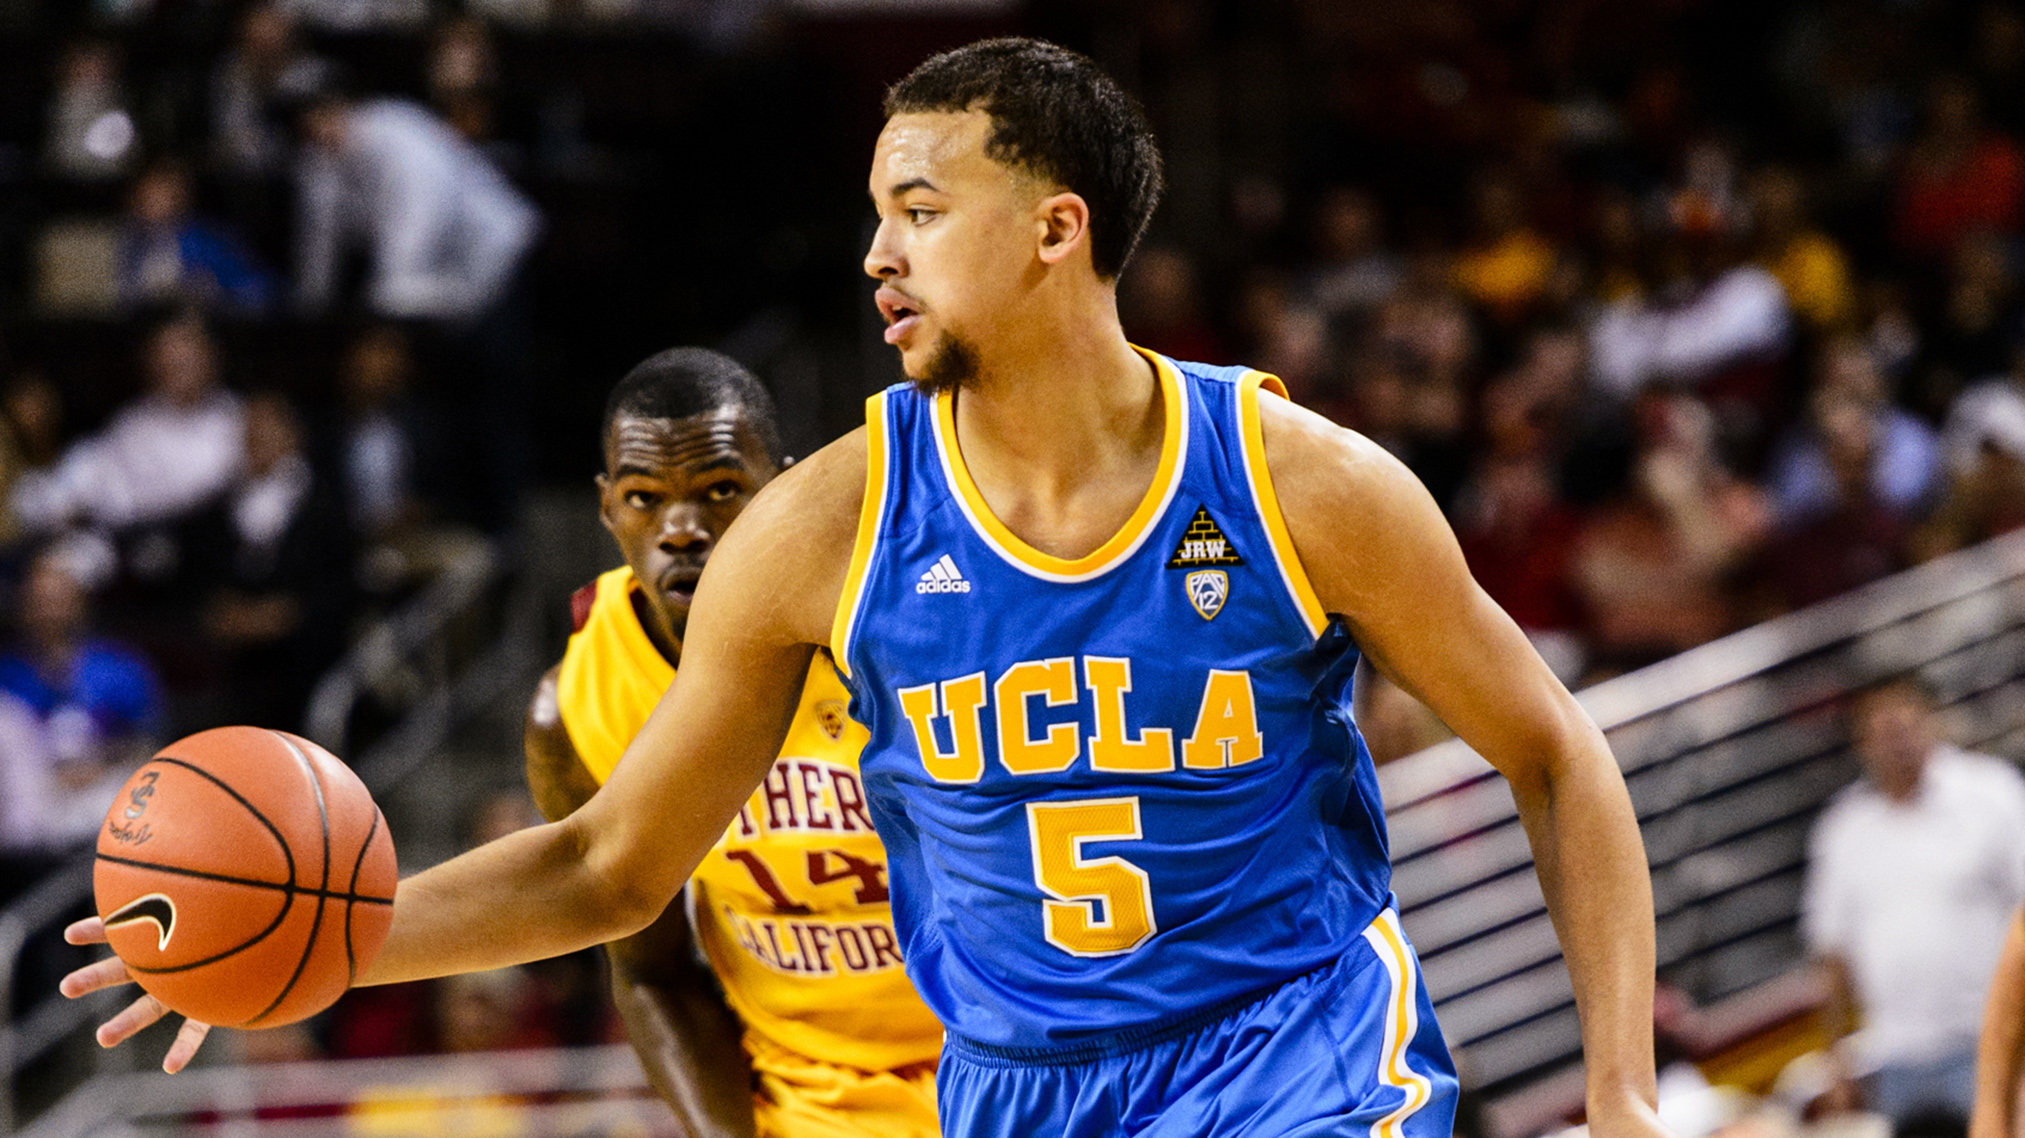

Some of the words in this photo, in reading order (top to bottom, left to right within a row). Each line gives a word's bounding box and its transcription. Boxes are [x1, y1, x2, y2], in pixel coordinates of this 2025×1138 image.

[1181, 541, 1225, 559] JRW
[916, 579, 971, 594] adidas
[1199, 591, 1219, 610] 12
[898, 655, 1263, 784] UCLA
[725, 850, 890, 915] 14
[1025, 796, 1158, 958] 5
